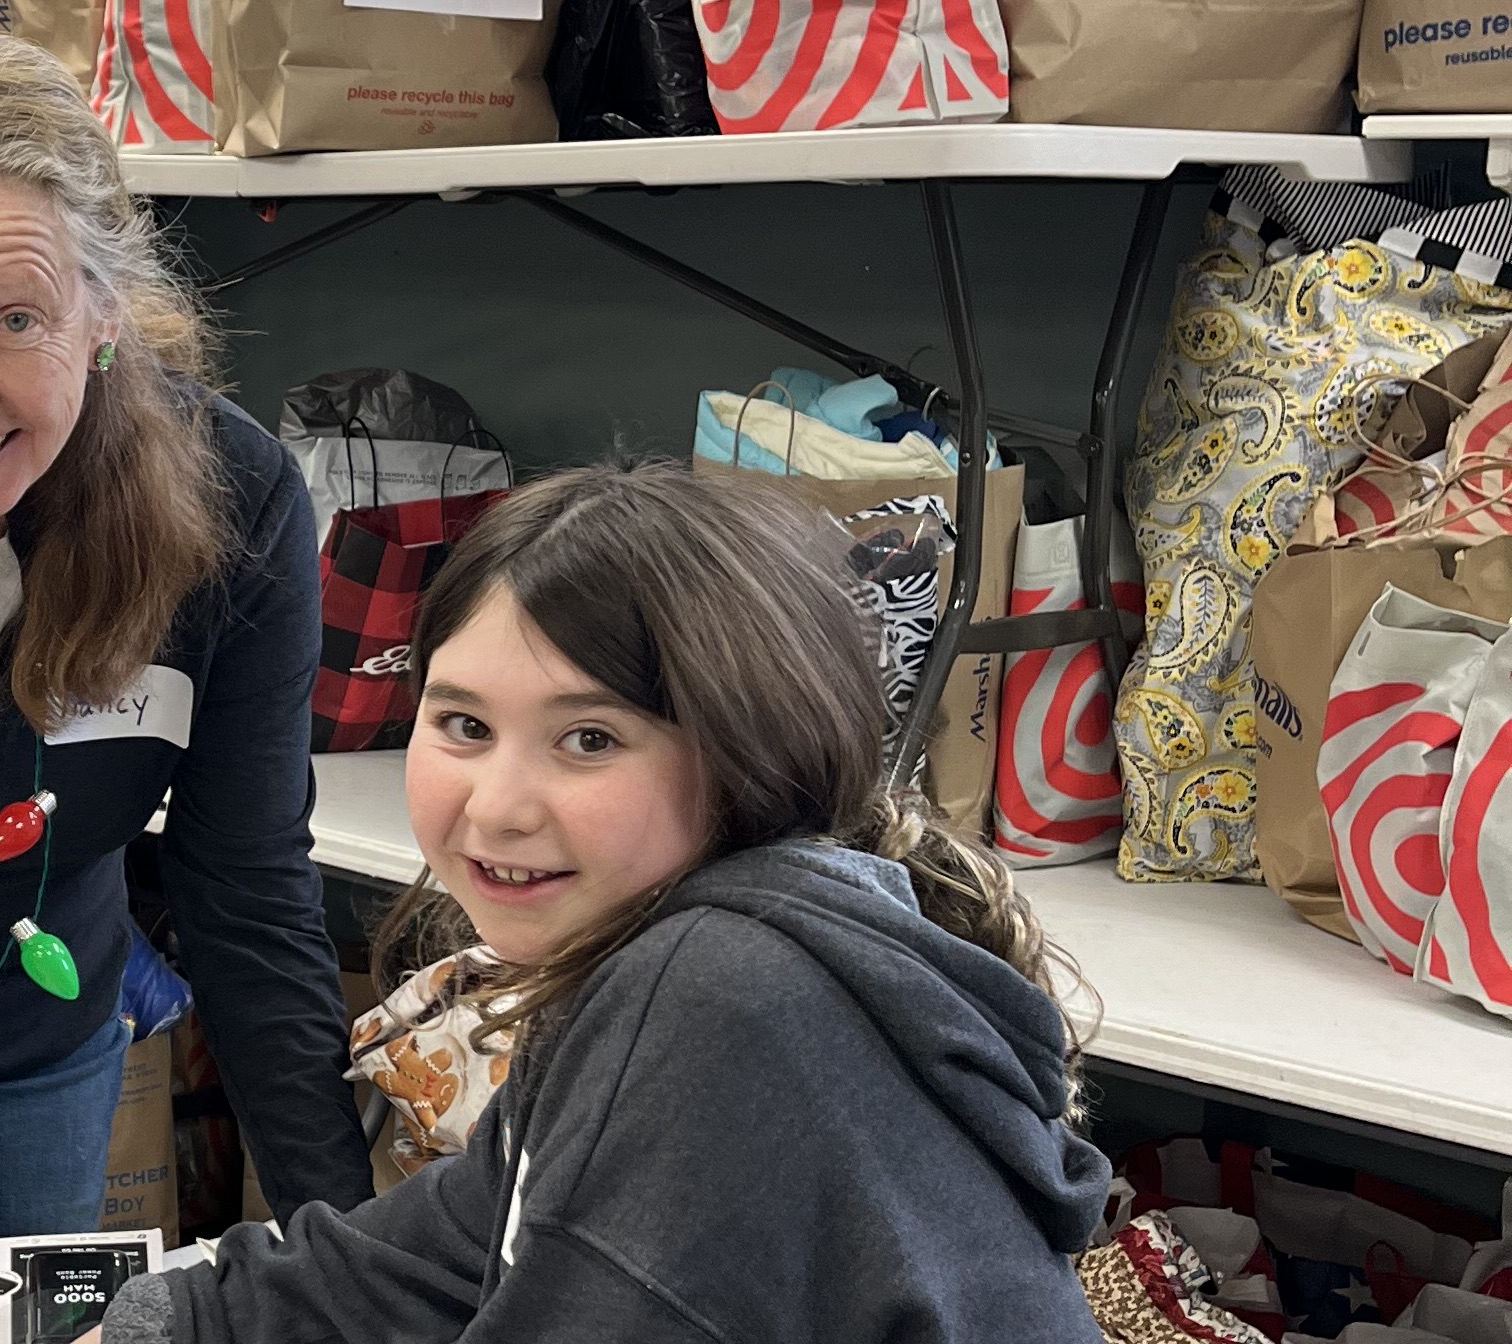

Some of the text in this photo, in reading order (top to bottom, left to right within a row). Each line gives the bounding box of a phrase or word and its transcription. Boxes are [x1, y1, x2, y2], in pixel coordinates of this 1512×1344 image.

[1384, 13, 1512, 54] please re
[347, 85, 516, 108] please recycle this bag
[349, 644, 412, 676] Ed
[68, 694, 149, 727] ancy
[970, 654, 991, 743] Marsh
[1254, 664, 1302, 738] halls
[105, 1164, 169, 1190] TCHER
[53, 1292, 106, 1304] 5000
